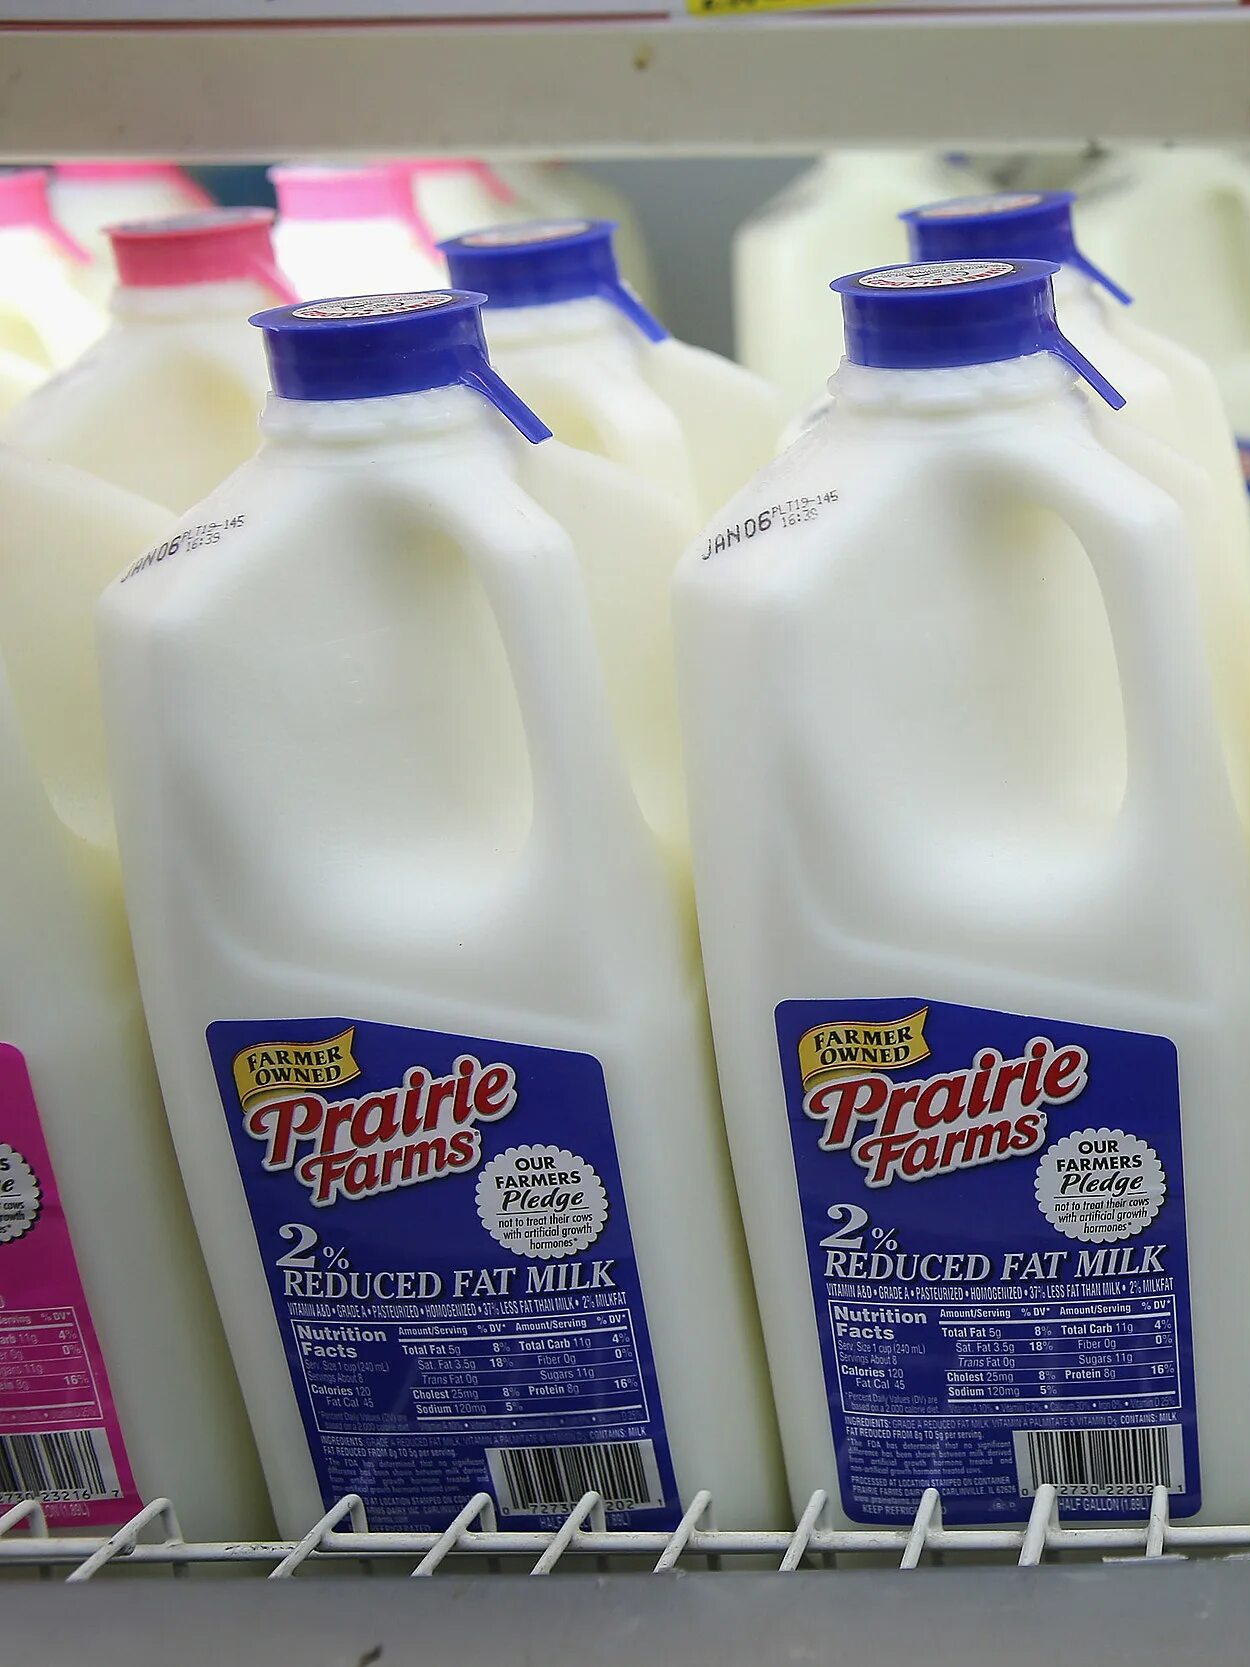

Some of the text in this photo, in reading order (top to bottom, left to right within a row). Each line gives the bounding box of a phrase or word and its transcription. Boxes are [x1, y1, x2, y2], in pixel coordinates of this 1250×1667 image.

[813, 1026, 913, 1051] FARMER
[247, 1045, 342, 1073] FARMER
[820, 1045, 909, 1066] OWNED
[255, 1064, 341, 1087] OWNED
[809, 1042, 1082, 1145] Prairie
[250, 1059, 509, 1165] Prairie
[858, 1114, 1041, 1182] Farms
[1078, 1140, 1119, 1154] OUR
[300, 1131, 474, 1200] Farms
[515, 1157, 556, 1171] OUR
[1057, 1155, 1142, 1172] FARMERS
[496, 1171, 581, 1189] FARMERS
[1060, 1171, 1143, 1197] Pledge
[4, 1202, 24, 1210] cows
[502, 1187, 584, 1212] Pledge
[1055, 1198, 1149, 1211] not to treat their cows
[499, 1214, 592, 1228] not to treat their cows
[1059, 1207, 1147, 1223] with artificial growth
[504, 1223, 591, 1239] with artificial growth
[824, 1244, 1166, 1281] REDUCED FAT MILK
[283, 1260, 615, 1299] REDUCED FAT MILK
[826, 1283, 855, 1298] VITAMIN
[879, 1286, 902, 1299] GRADE
[904, 1287, 909, 1299] A
[916, 1287, 963, 1300] PASTEURIZED
[971, 1286, 1022, 1300] HOMOGENIZED
[1030, 1286, 1045, 1299] 37%
[1047, 1285, 1064, 1298] LESS
[1067, 1284, 1079, 1296] FAT
[1081, 1283, 1100, 1296] THAN
[1102, 1282, 1121, 1295] MILK
[1129, 1281, 1141, 1293] 2%
[1143, 1278, 1173, 1293] MILKFAT
[834, 1306, 927, 1324] Nutrition
[940, 1308, 1011, 1319] Amount/Serving
[1060, 1304, 1131, 1315] Amount/Serving
[299, 1325, 386, 1342] Nutrition
[836, 1322, 895, 1340] Facts
[302, 1342, 357, 1359] Facts
[41, 1490, 119, 1502] 23216 7
[1053, 1485, 1098, 1494] 2730
[1084, 1499, 1120, 1510] GALLON
